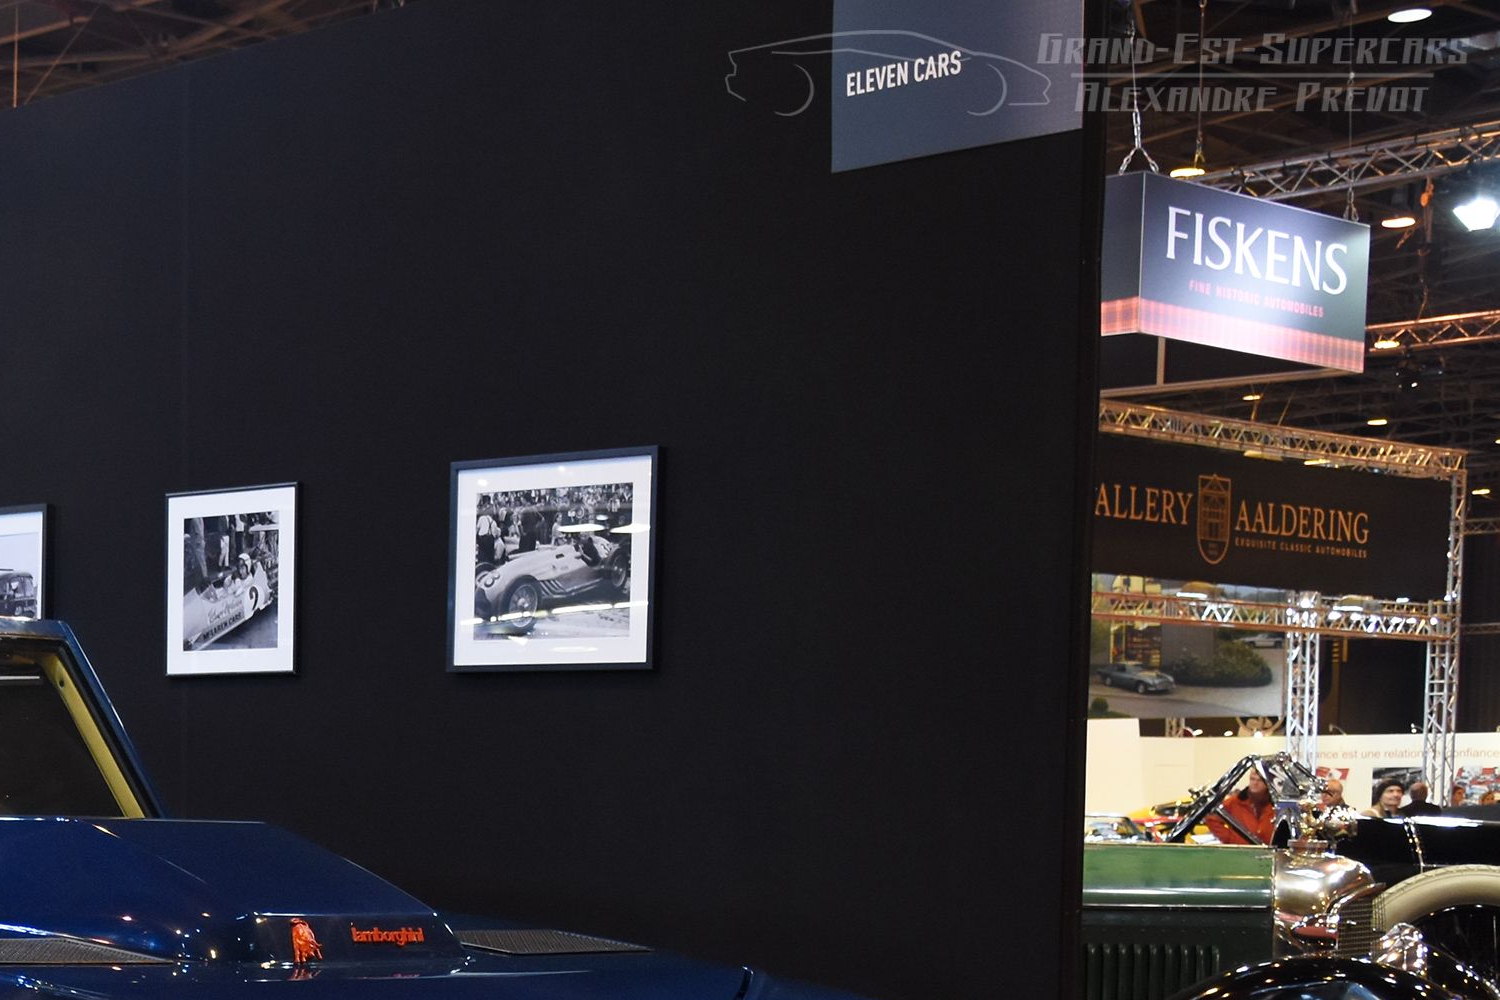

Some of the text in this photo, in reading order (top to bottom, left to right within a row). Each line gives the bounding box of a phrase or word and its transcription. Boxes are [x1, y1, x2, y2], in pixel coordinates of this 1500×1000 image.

[846, 50, 962, 97] ELEVEN CARS
[1166, 206, 1348, 295] FISKENS
[1188, 280, 1324, 318] FINE HISTORIC AUTOMOBILES
[1094, 482, 1369, 544] ALLERY AALDERING
[1235, 537, 1277, 551] EXQUISITE
[1280, 541, 1312, 554] CLASSIC
[1315, 545, 1368, 559] AUTOMOBILES
[1446, 747, 1500, 759] onfiance
